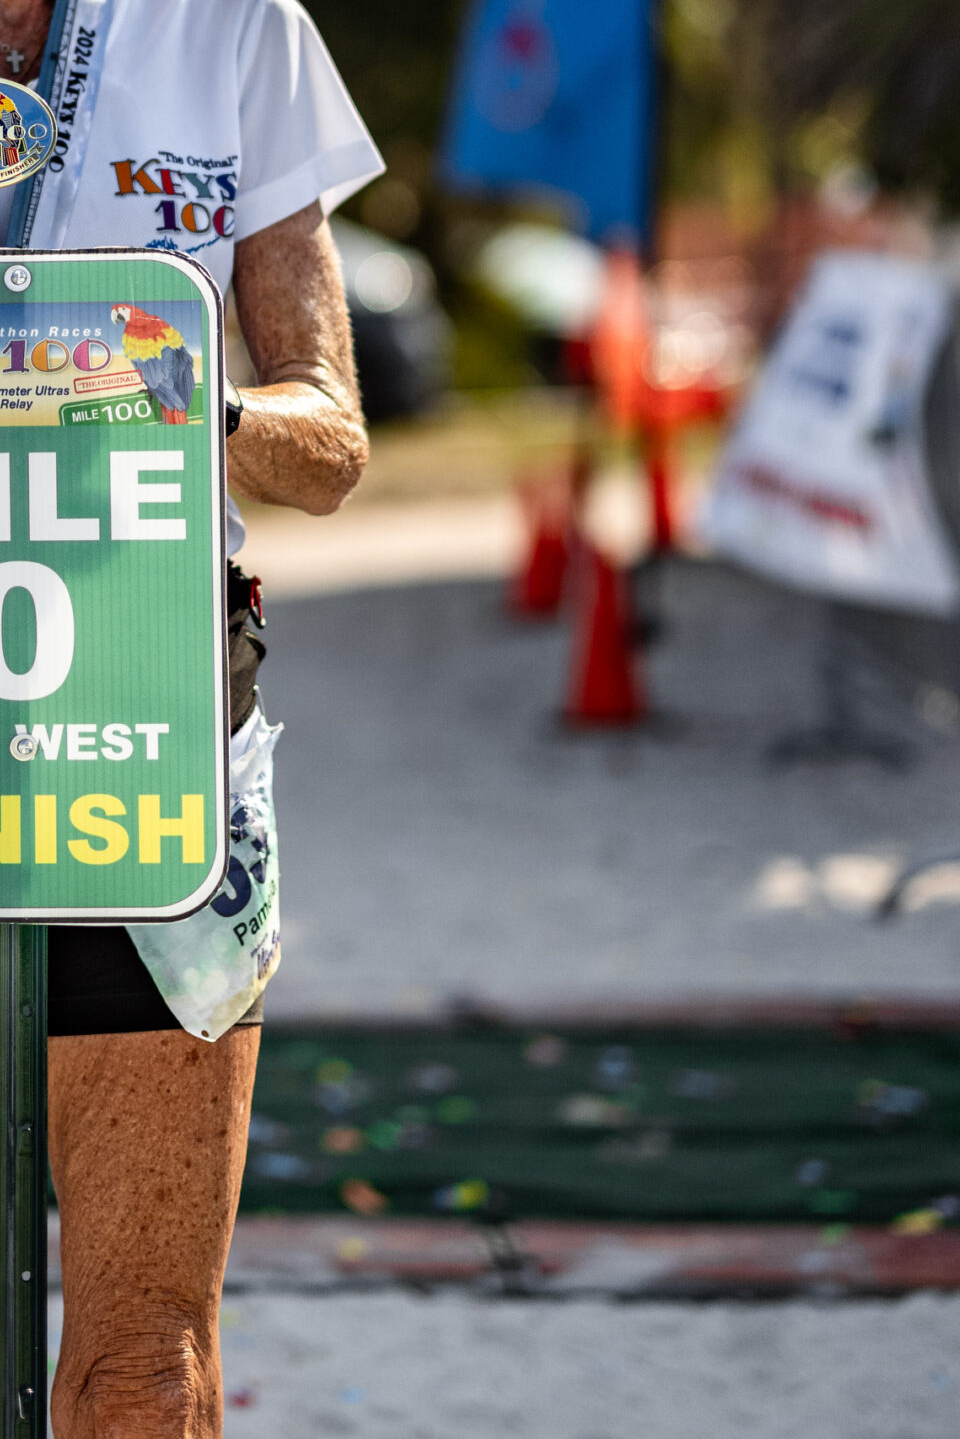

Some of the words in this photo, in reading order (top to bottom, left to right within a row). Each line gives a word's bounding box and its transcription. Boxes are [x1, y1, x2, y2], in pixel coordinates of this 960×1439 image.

[72, 26, 96, 65] 2024
[59, 69, 87, 125] KEYS
[1, 157, 35, 177] FINISHER
[49, 134, 71, 172] 100
[110, 158, 237, 202] KEYS
[154, 200, 235, 238] 100
[48, 326, 102, 337] Races
[0, 399, 33, 411] Relay
[35, 386, 70, 396] Ultras
[71, 409, 100, 423] MILE
[101, 400, 152, 423] 100
[15, 723, 169, 760] WEST
